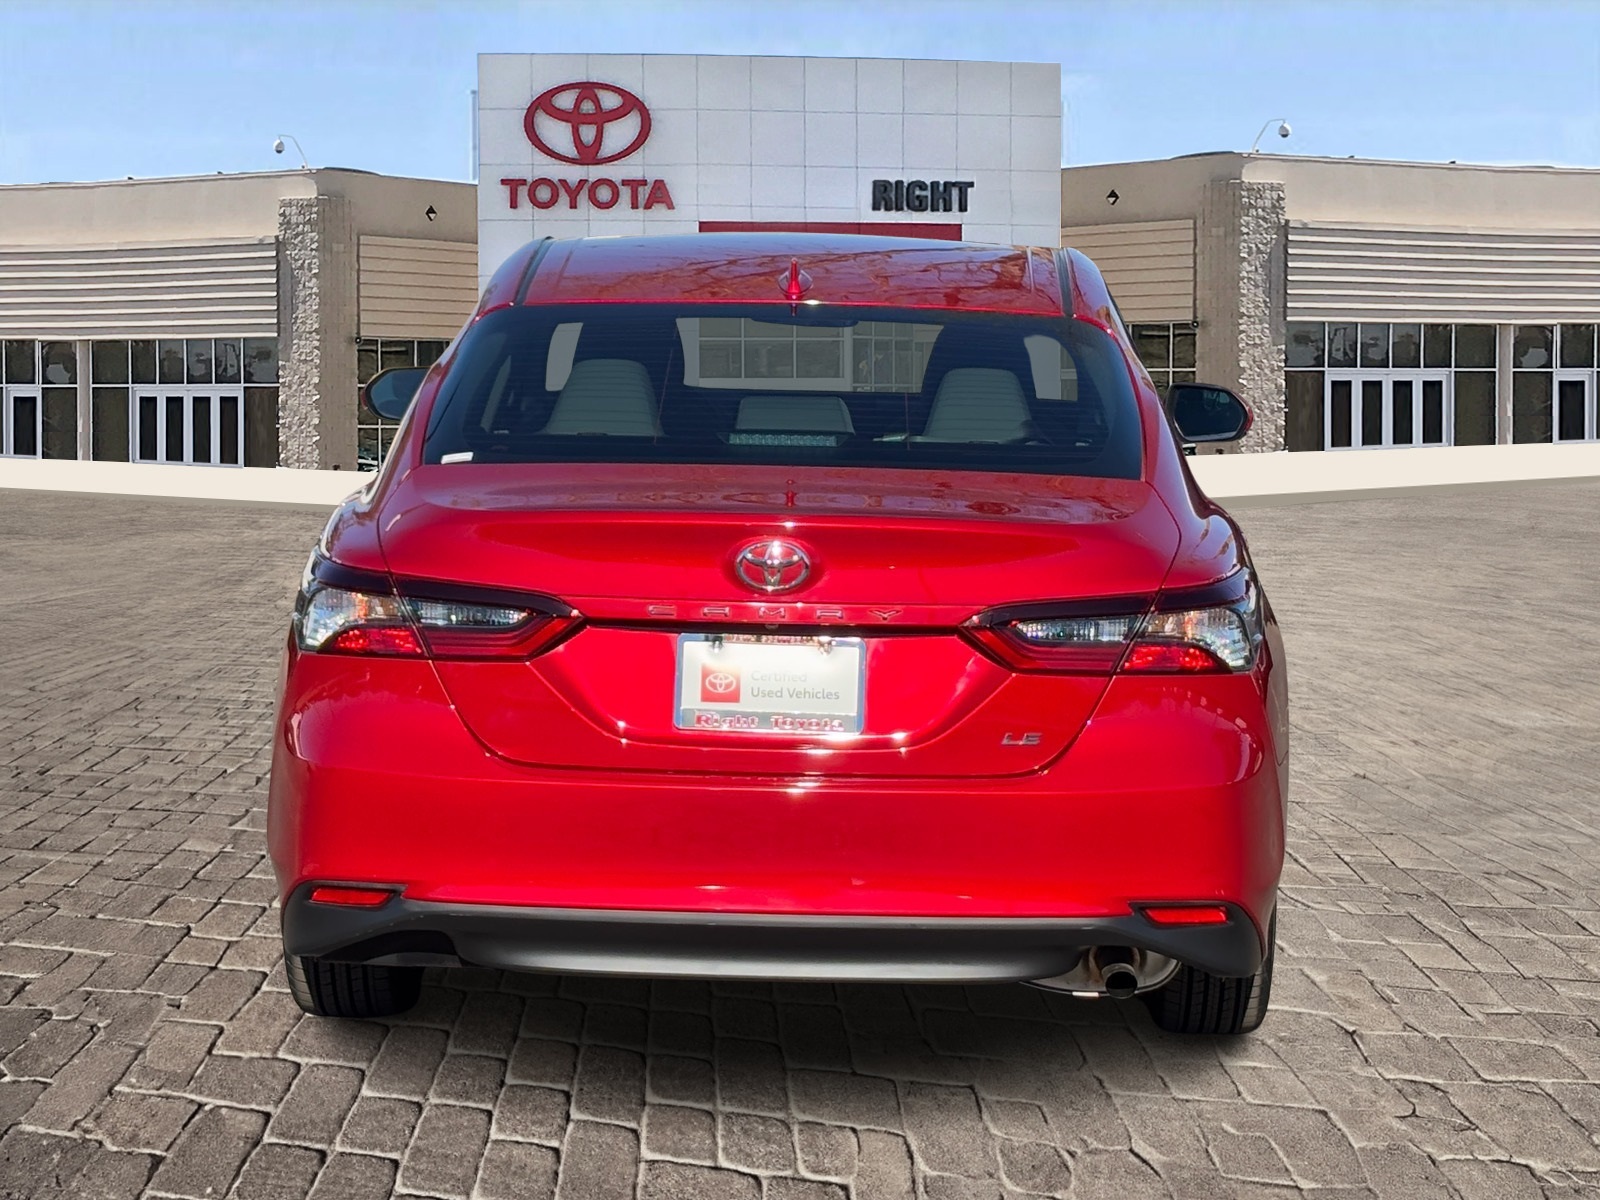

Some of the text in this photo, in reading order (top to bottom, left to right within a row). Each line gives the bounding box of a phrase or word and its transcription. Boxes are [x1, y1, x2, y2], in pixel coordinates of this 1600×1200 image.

[500, 178, 675, 210] TOYOTA
[872, 179, 975, 213] RIGHT
[648, 604, 902, 621] CAMRY
[751, 670, 808, 683] Certified
[751, 687, 840, 701] Used Vehicles
[695, 711, 760, 730] Right
[1001, 732, 1043, 745] LE
